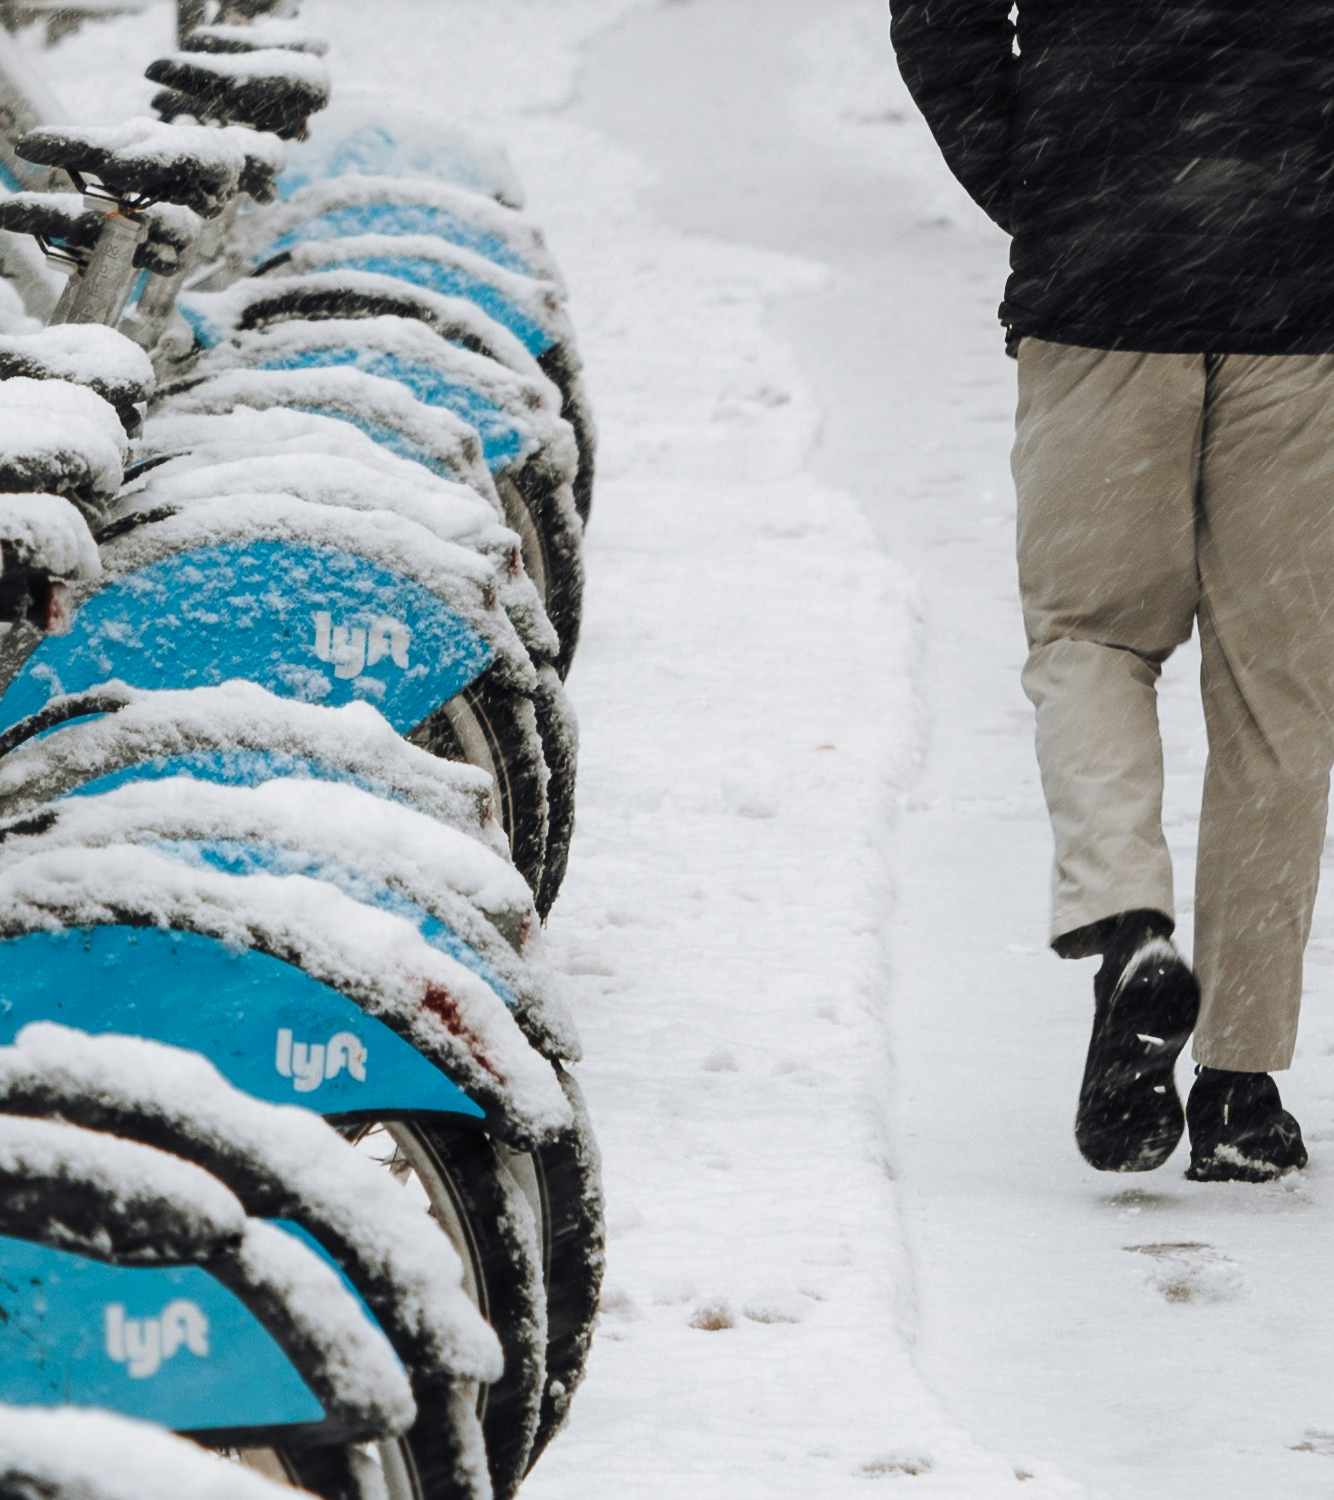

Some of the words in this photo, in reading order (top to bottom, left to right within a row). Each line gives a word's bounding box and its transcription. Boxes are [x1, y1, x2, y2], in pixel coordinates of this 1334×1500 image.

[310, 609, 414, 681] lyft
[274, 1030, 368, 1093] lyft
[103, 1298, 210, 1379] lyft
